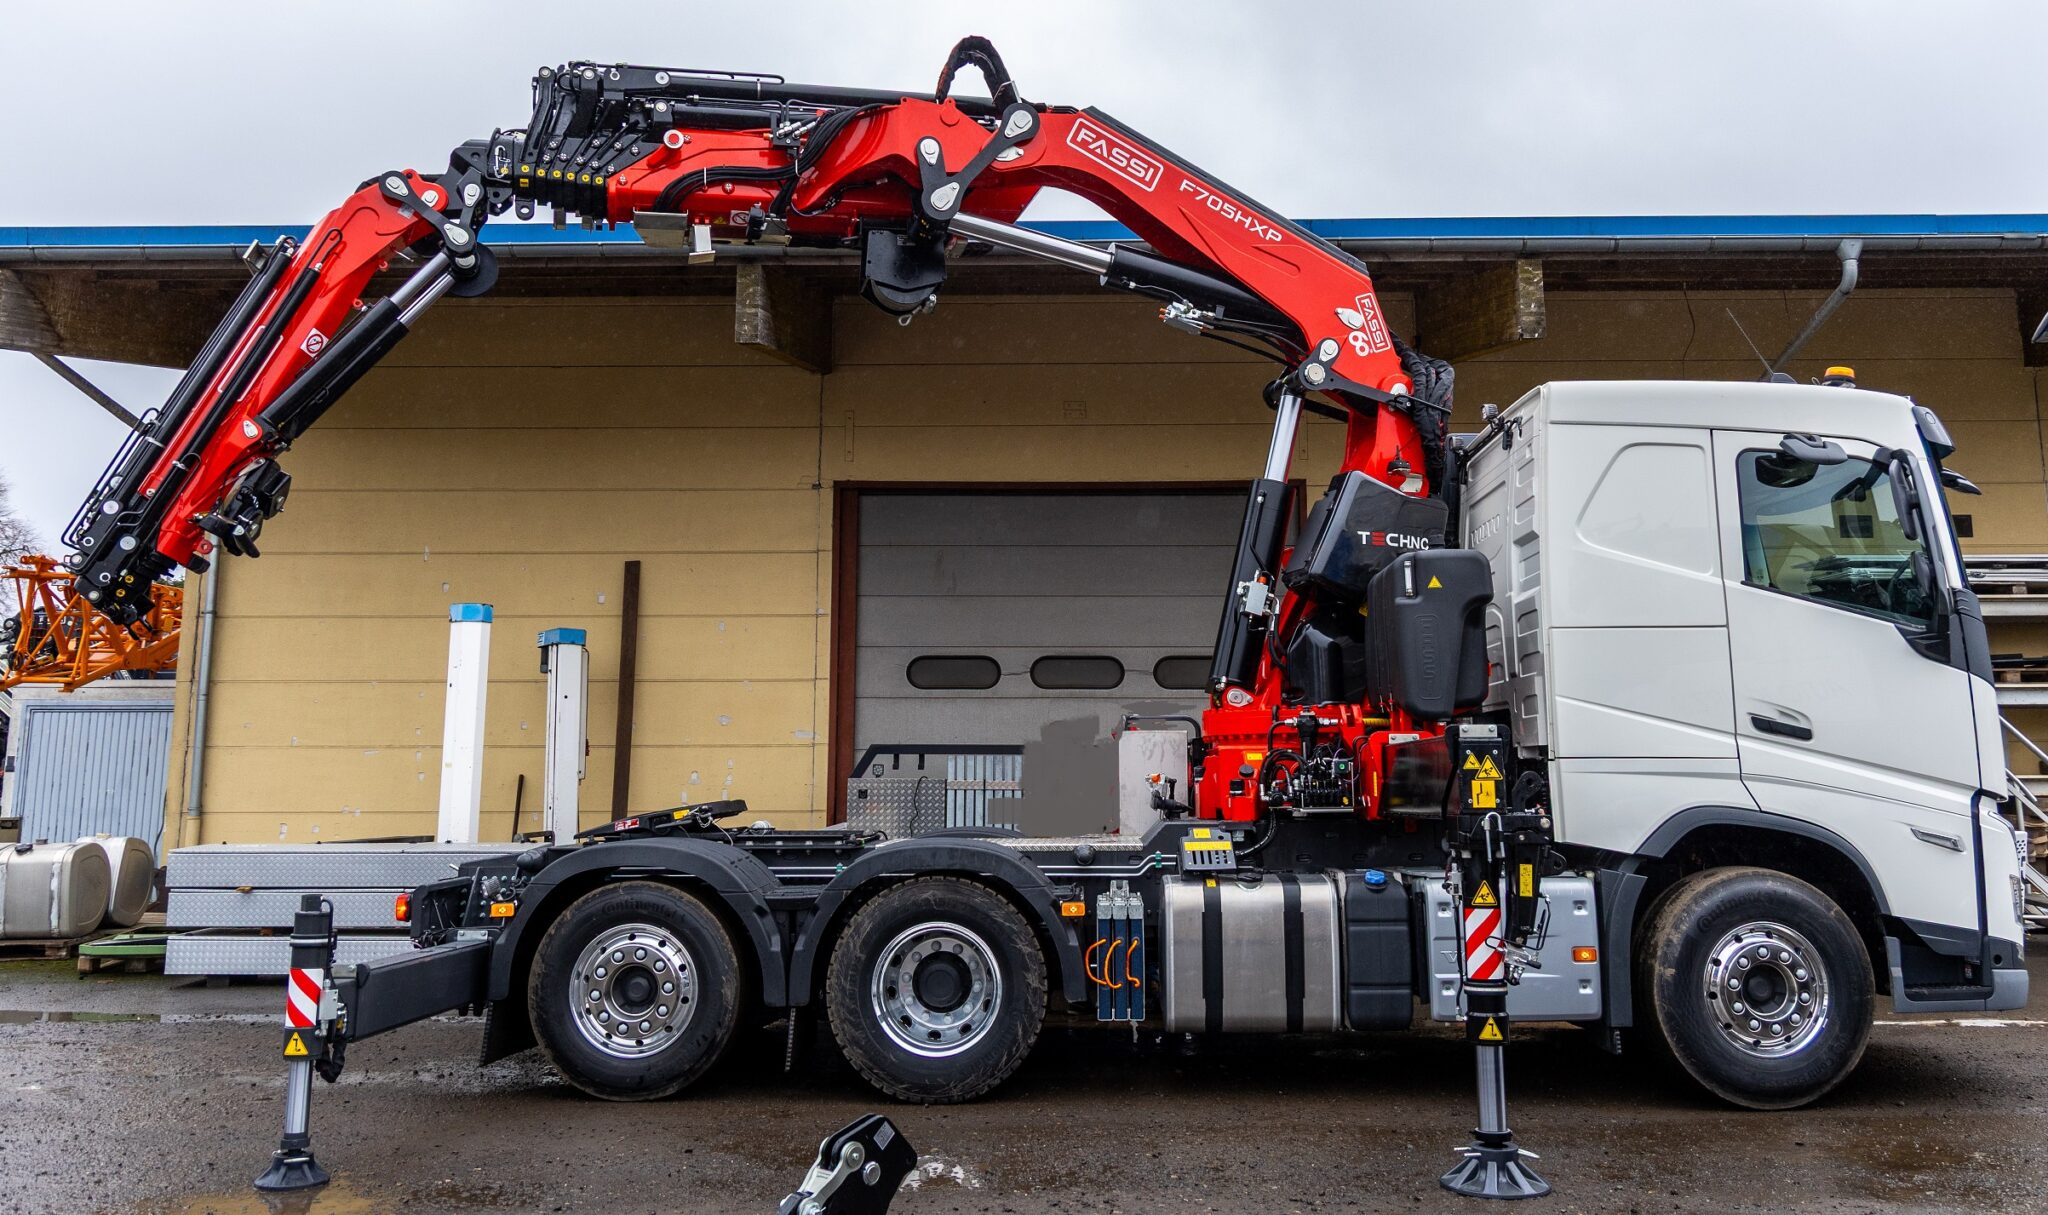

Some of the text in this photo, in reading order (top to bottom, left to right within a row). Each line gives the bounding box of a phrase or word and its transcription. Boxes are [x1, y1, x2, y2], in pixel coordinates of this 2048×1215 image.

[1076, 128, 1154, 182] FASSI
[1179, 179, 1282, 242] F705HXP
[1361, 298, 1386, 348] FASSI
